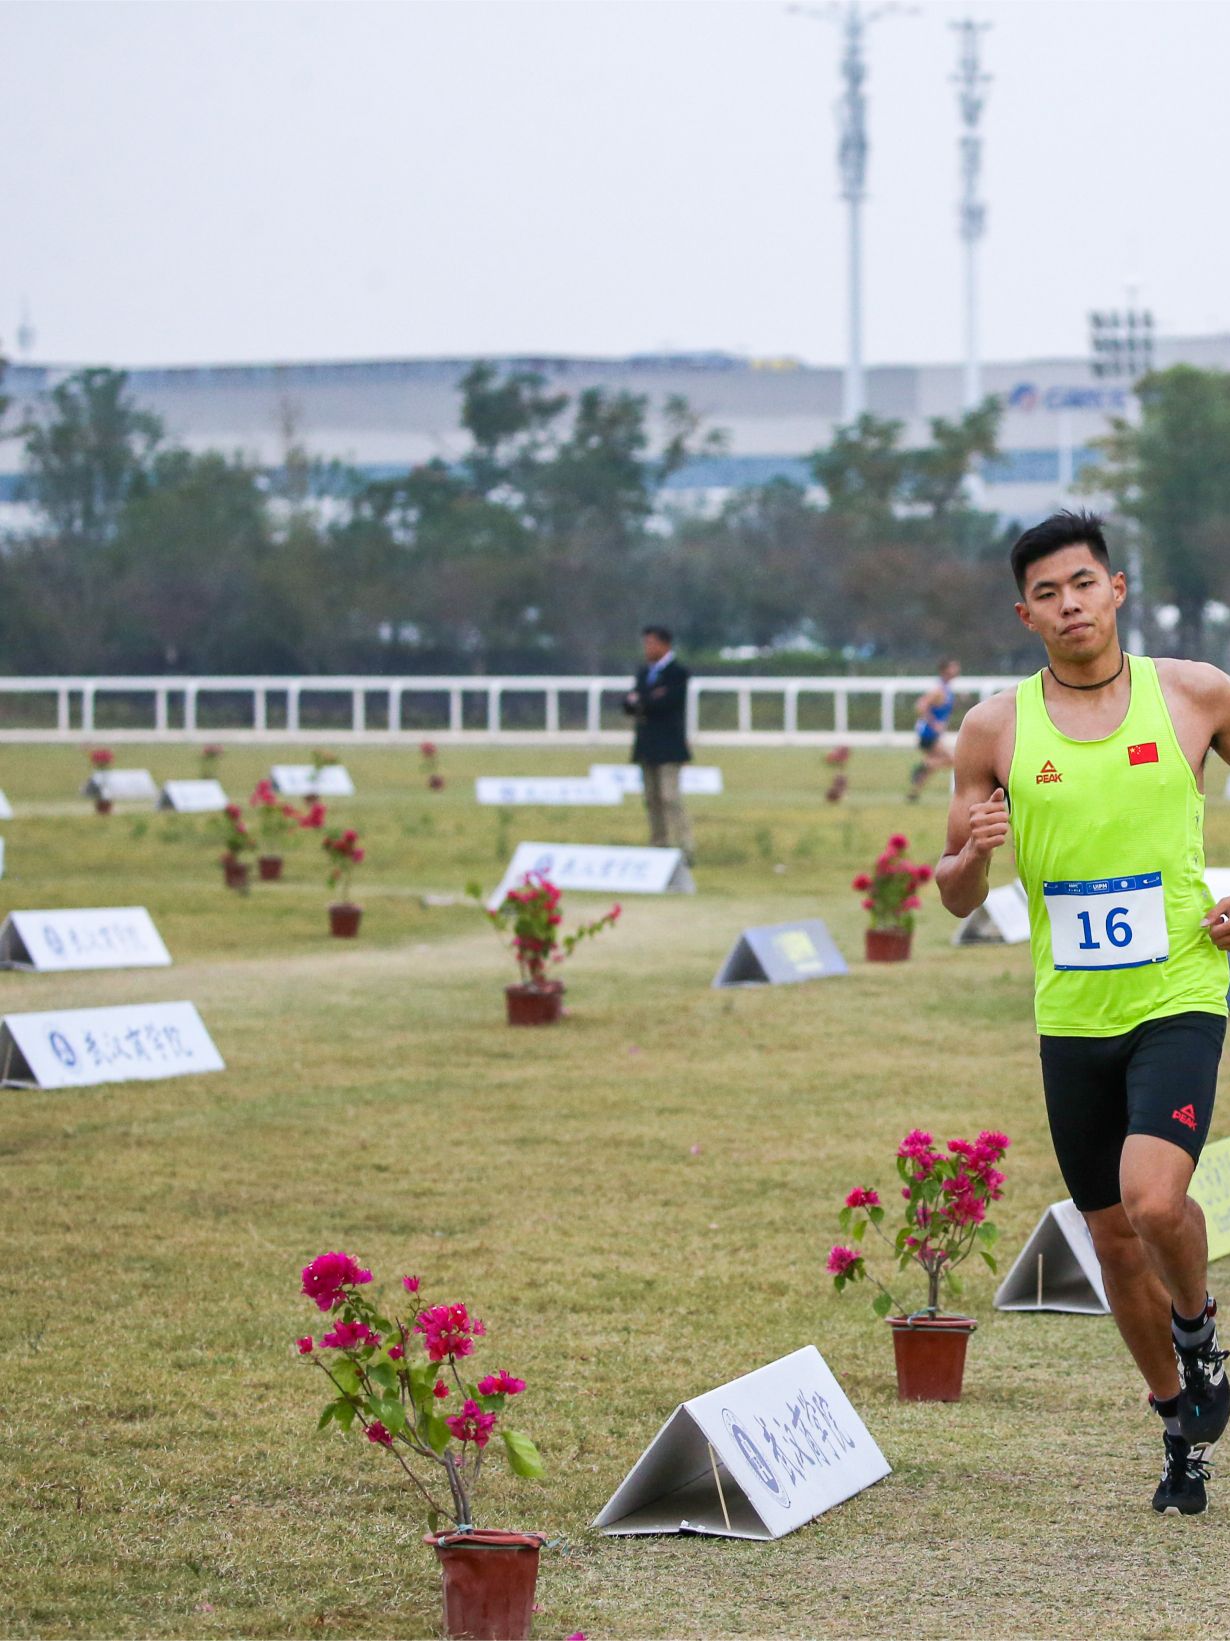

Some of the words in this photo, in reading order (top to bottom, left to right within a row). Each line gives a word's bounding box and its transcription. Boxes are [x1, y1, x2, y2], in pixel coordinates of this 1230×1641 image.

[1036, 773, 1063, 784] PEAK
[1077, 907, 1133, 949] 16
[1172, 1110, 1198, 1131] PEAK
